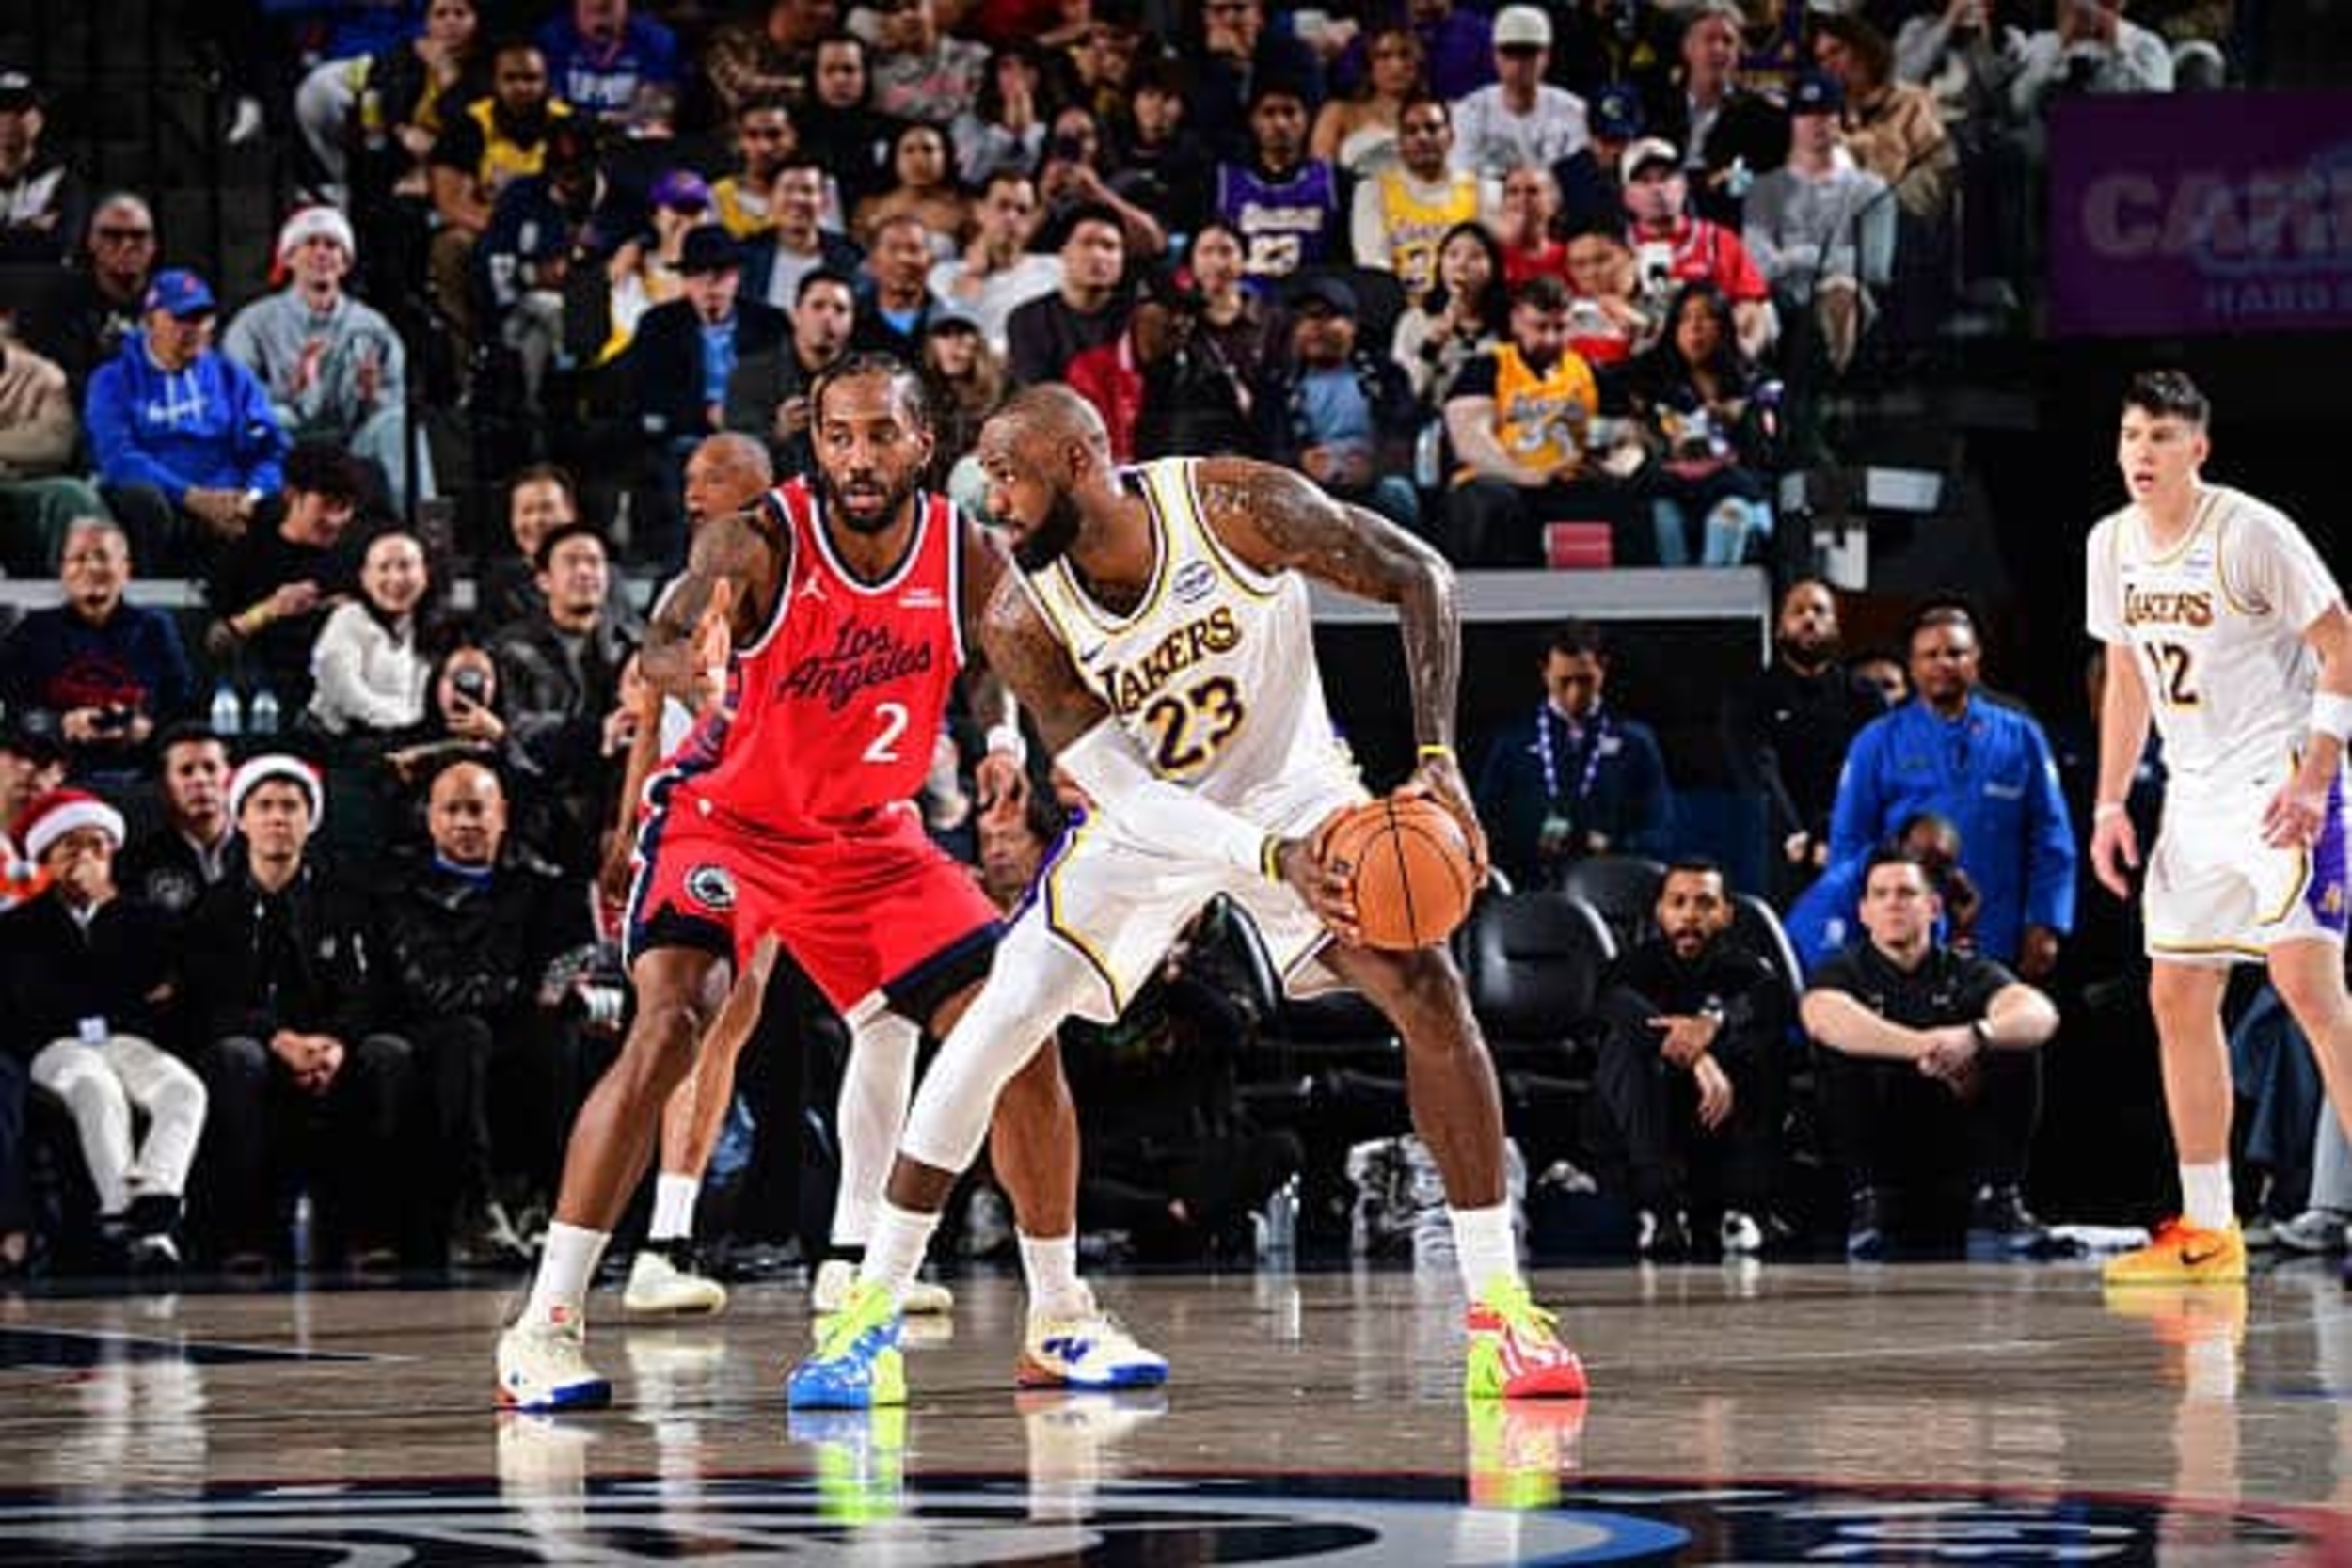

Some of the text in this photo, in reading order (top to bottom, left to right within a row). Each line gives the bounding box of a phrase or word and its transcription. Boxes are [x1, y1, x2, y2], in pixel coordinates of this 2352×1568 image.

[2124, 582, 2215, 628] LAKERS
[830, 614, 892, 664] Los
[1096, 605, 1242, 722] LAKERS
[777, 640, 932, 714] Angeles
[2143, 641, 2201, 705] 12
[861, 702, 910, 763] 2
[1143, 674, 1245, 772] 23
